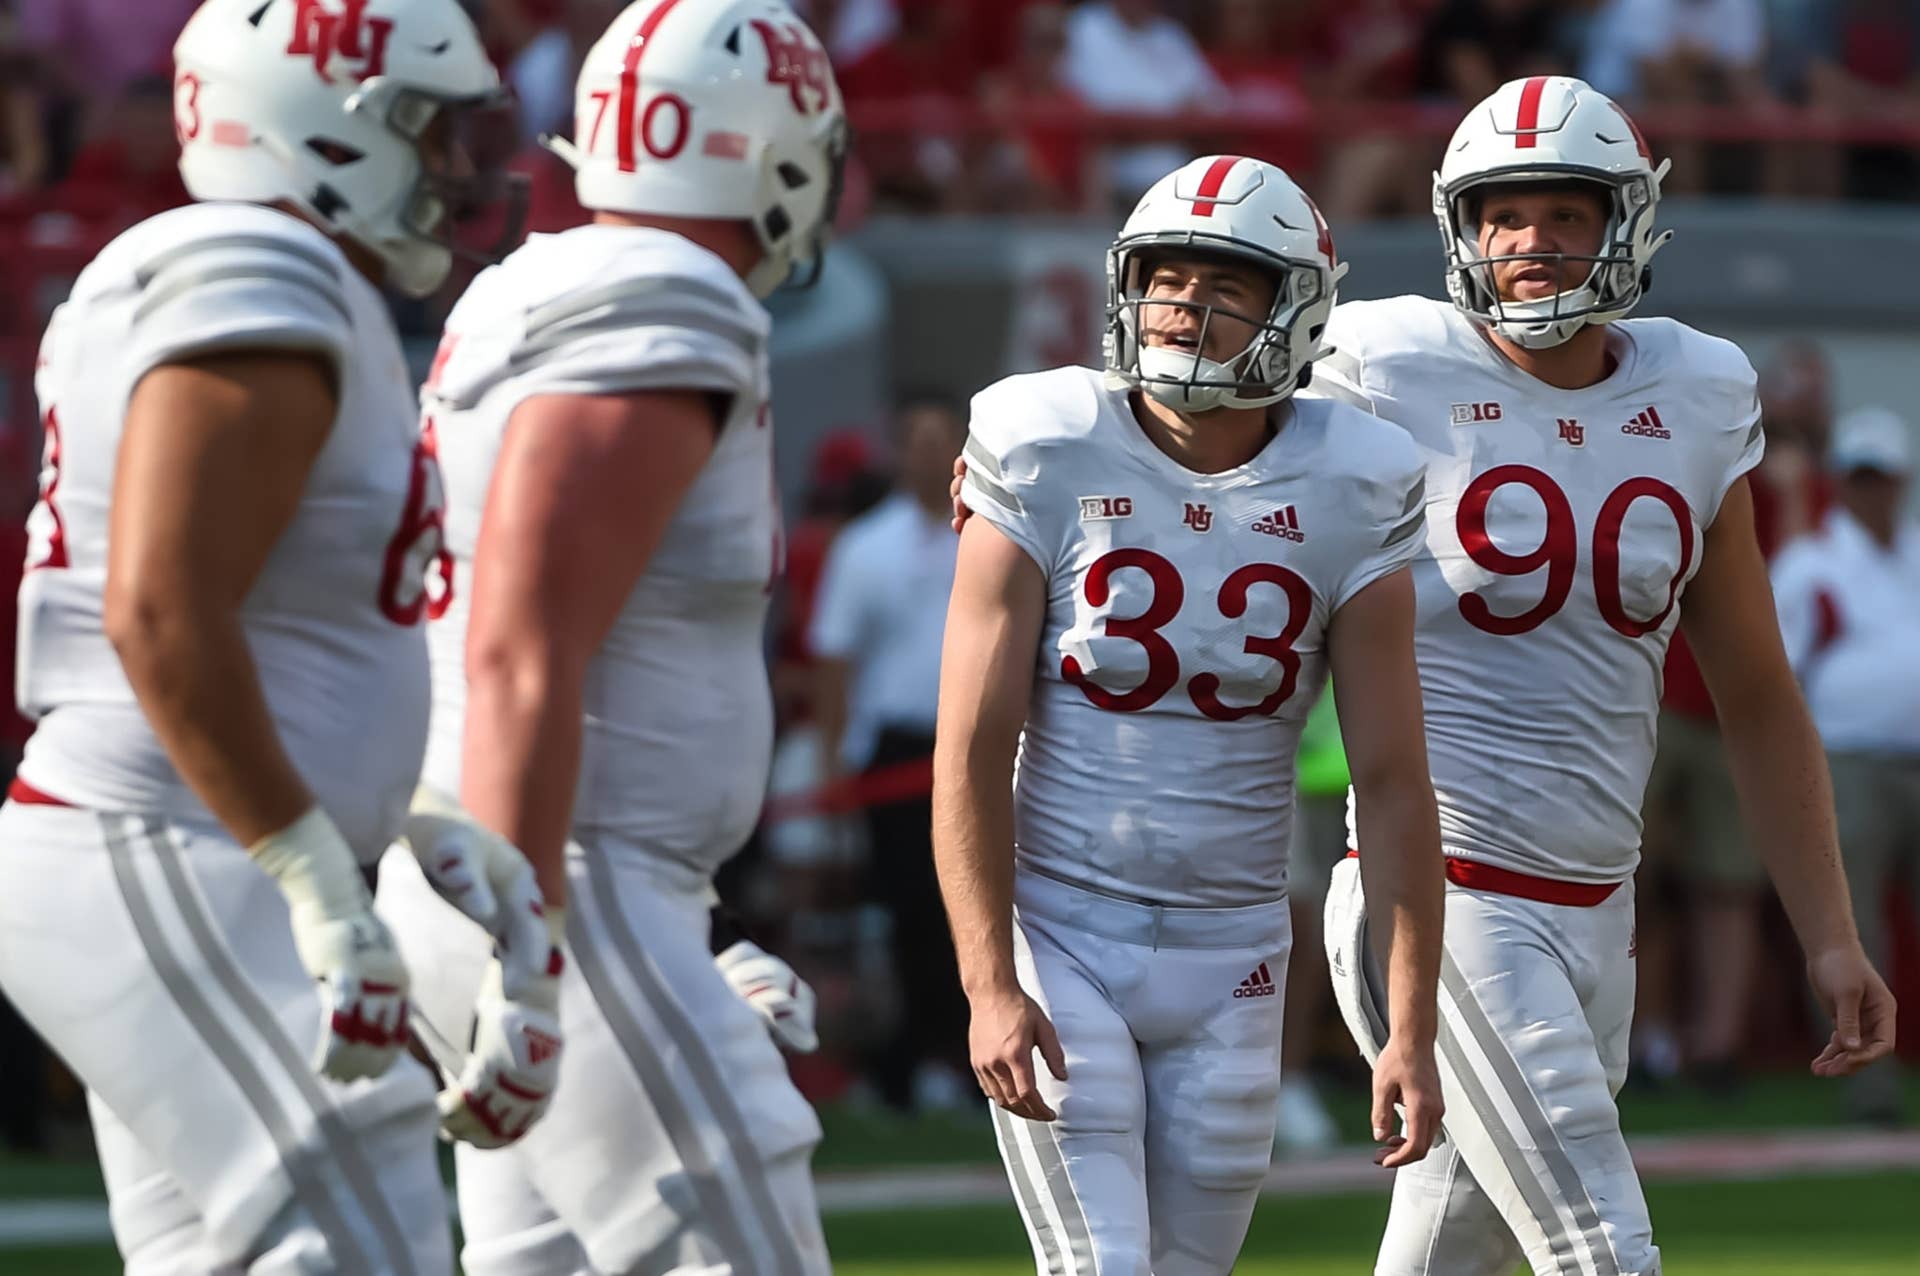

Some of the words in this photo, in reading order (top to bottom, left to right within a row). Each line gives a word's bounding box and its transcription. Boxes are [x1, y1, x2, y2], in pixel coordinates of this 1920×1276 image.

[1557, 419, 1584, 446] NU
[1621, 424, 1671, 440] adidas
[1183, 503, 1212, 531] NU
[1252, 522, 1305, 543] adidas
[1456, 464, 1694, 638] 90
[1061, 548, 1312, 721] 33
[1233, 984, 1276, 998] adidas
